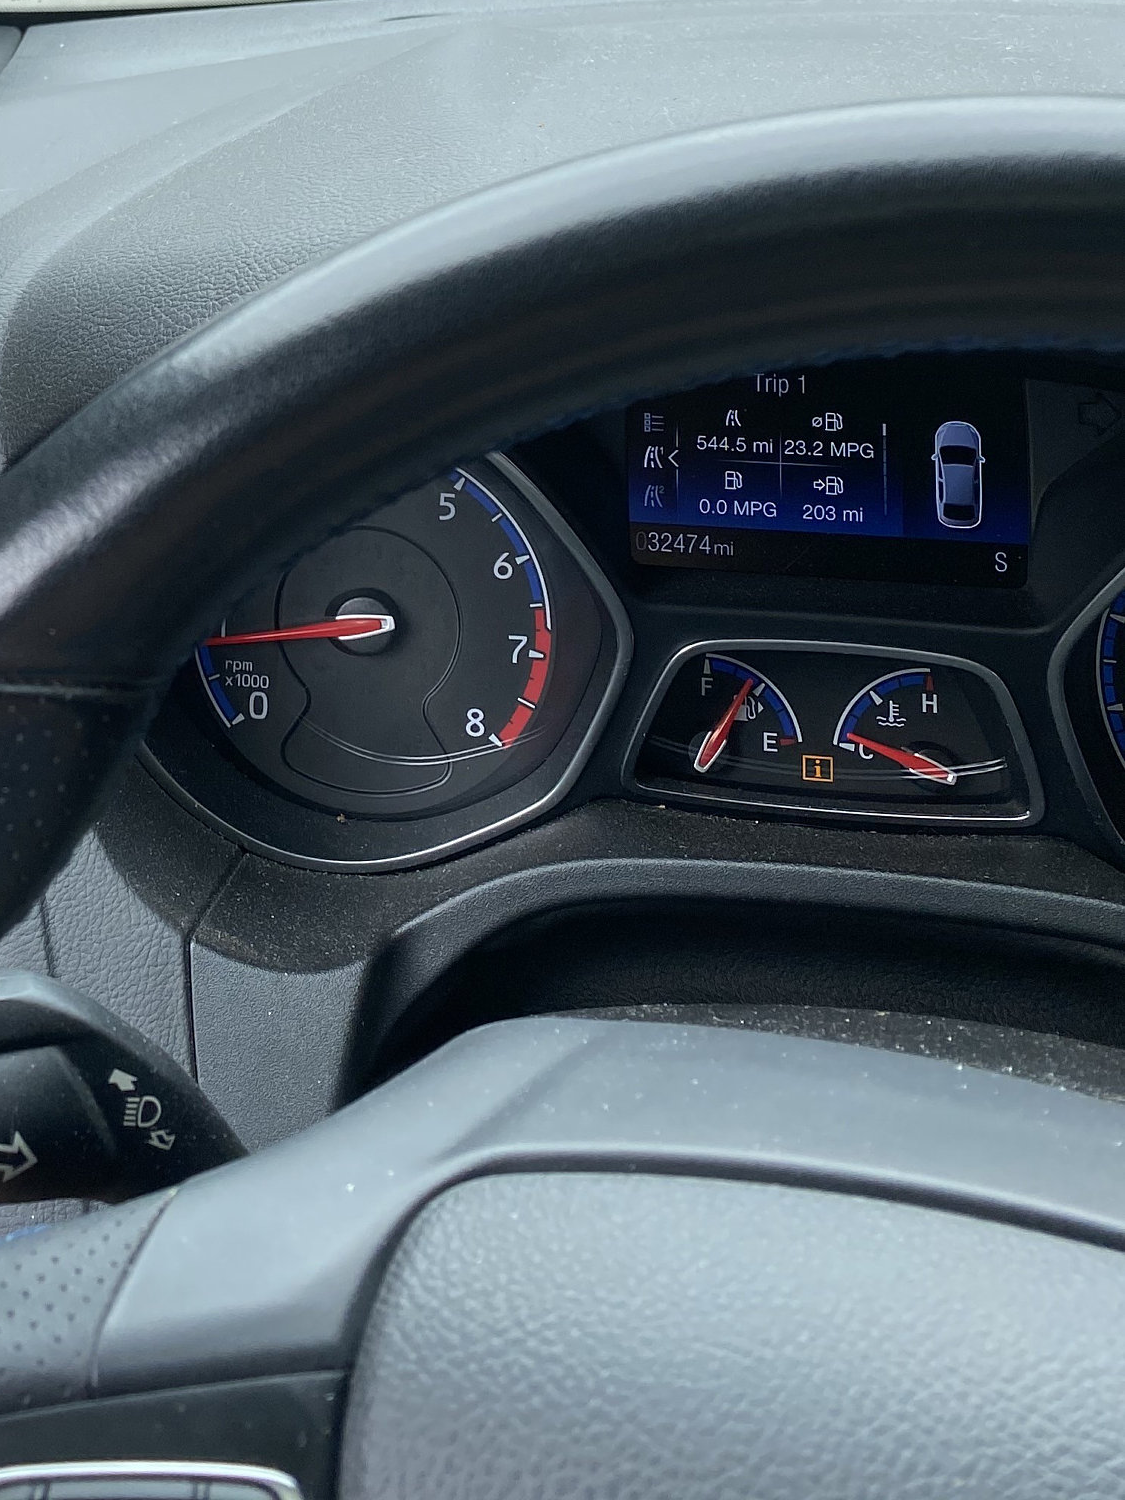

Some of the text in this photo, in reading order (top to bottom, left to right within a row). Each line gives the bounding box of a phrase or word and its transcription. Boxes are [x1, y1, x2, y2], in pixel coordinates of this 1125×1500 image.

[753, 372, 806, 398] Trip 1
[695, 434, 774, 454] 544.5 mi
[783, 439, 876, 459] 23.2 MPG
[438, 491, 457, 522] 5
[698, 497, 778, 519] 0.0 MPG
[801, 503, 865, 523] 203 mi
[492, 551, 515, 580] 6
[993, 552, 1009, 574] S
[507, 634, 529, 664] 7
[224, 659, 254, 674] rpm
[224, 673, 271, 690] x1000
[700, 676, 715, 697] F
[248, 690, 269, 720] 0
[920, 692, 939, 715] H
[463, 707, 486, 738] 8
[762, 731, 779, 753] E
